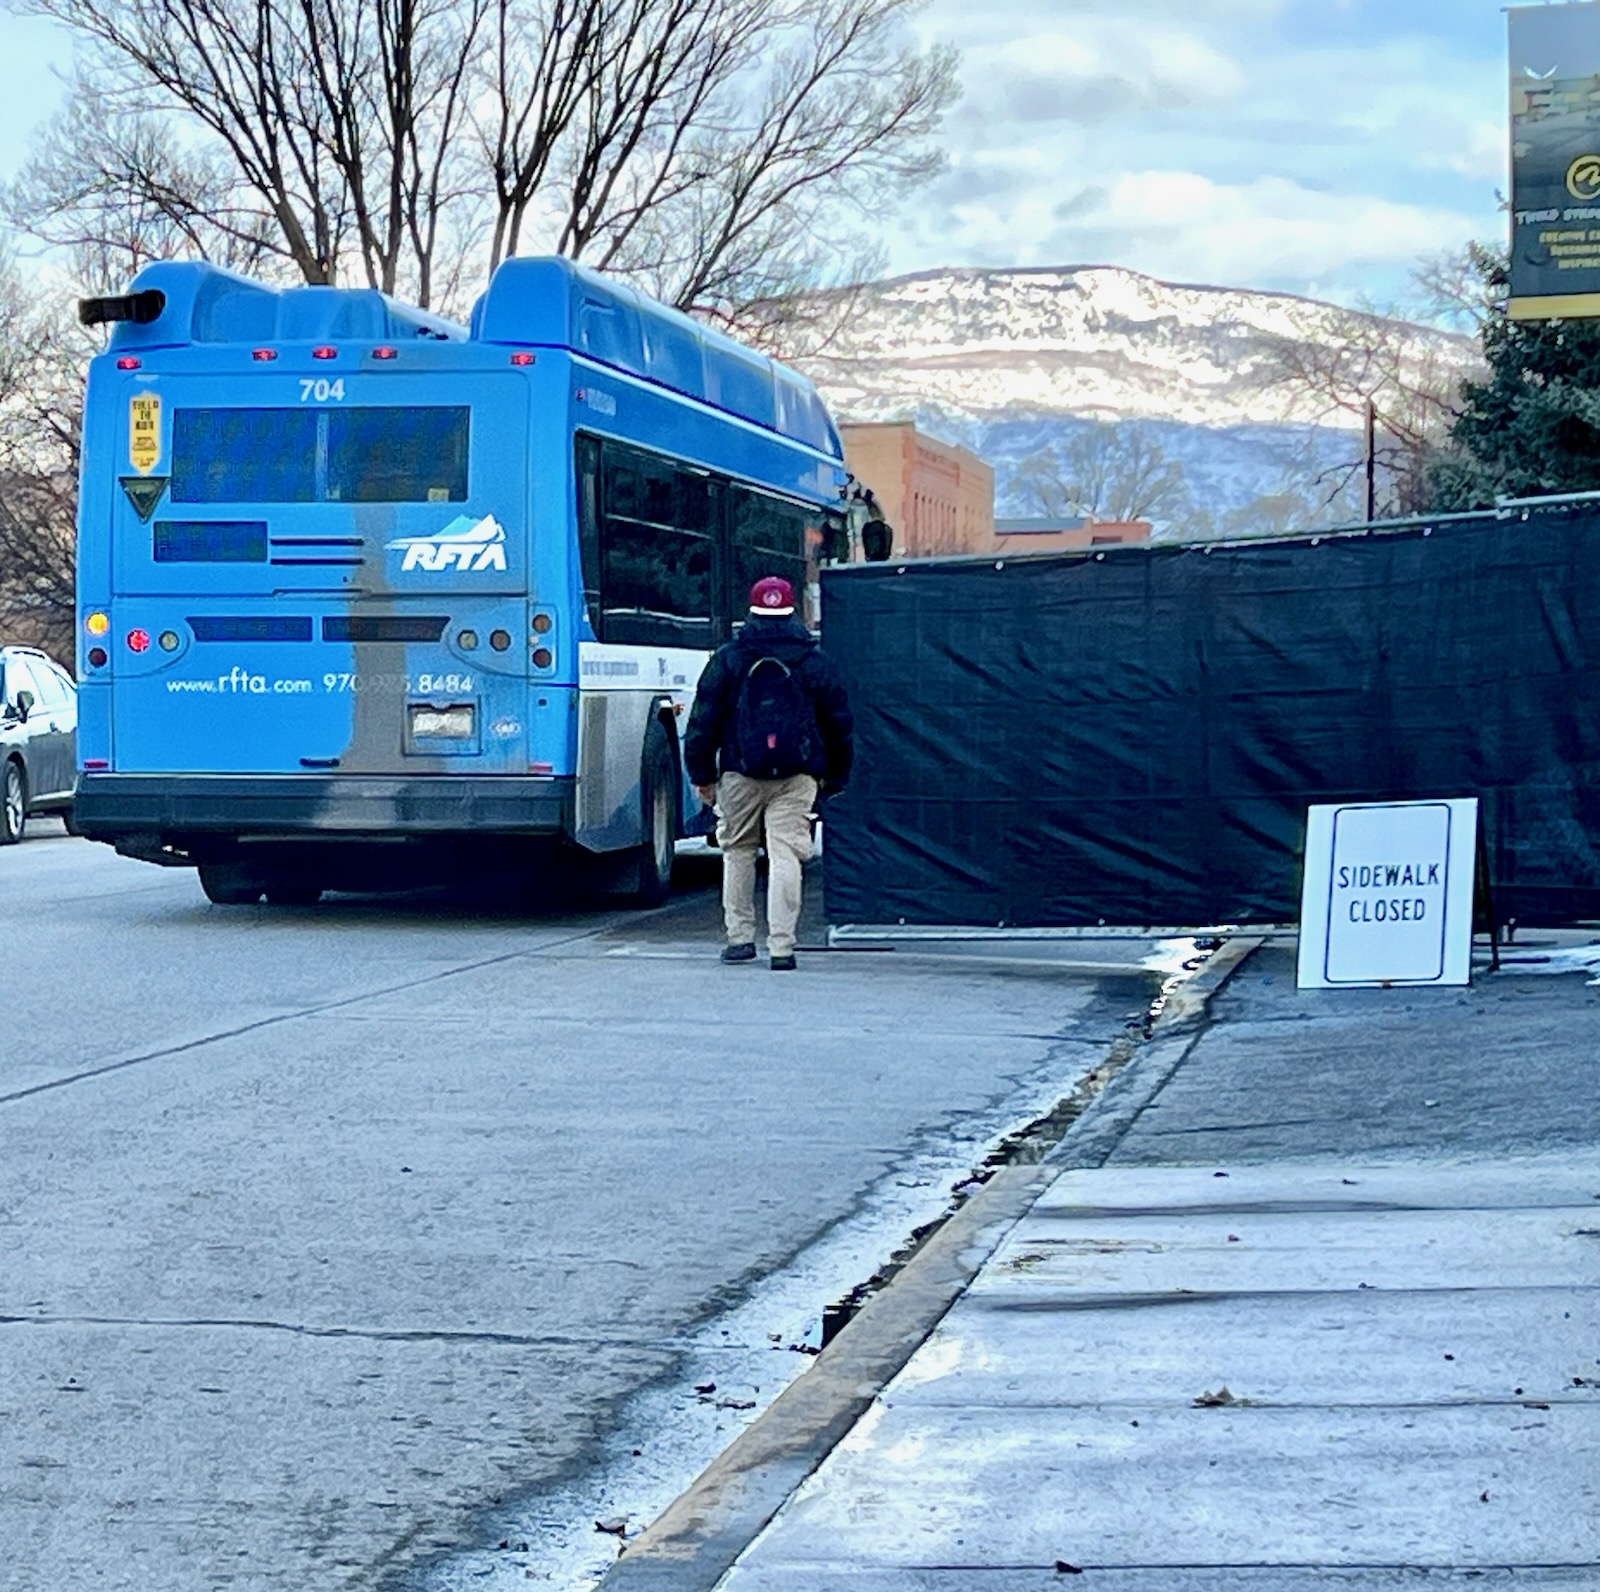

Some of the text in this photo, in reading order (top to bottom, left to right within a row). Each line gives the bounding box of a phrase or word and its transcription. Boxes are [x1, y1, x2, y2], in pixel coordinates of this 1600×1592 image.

[299, 378, 346, 402] 704
[401, 542, 507, 571] RFTA
[166, 665, 312, 694] www.rfta.com
[1337, 863, 1441, 889] SIDEWALK
[1349, 898, 1426, 923] CLOSED
